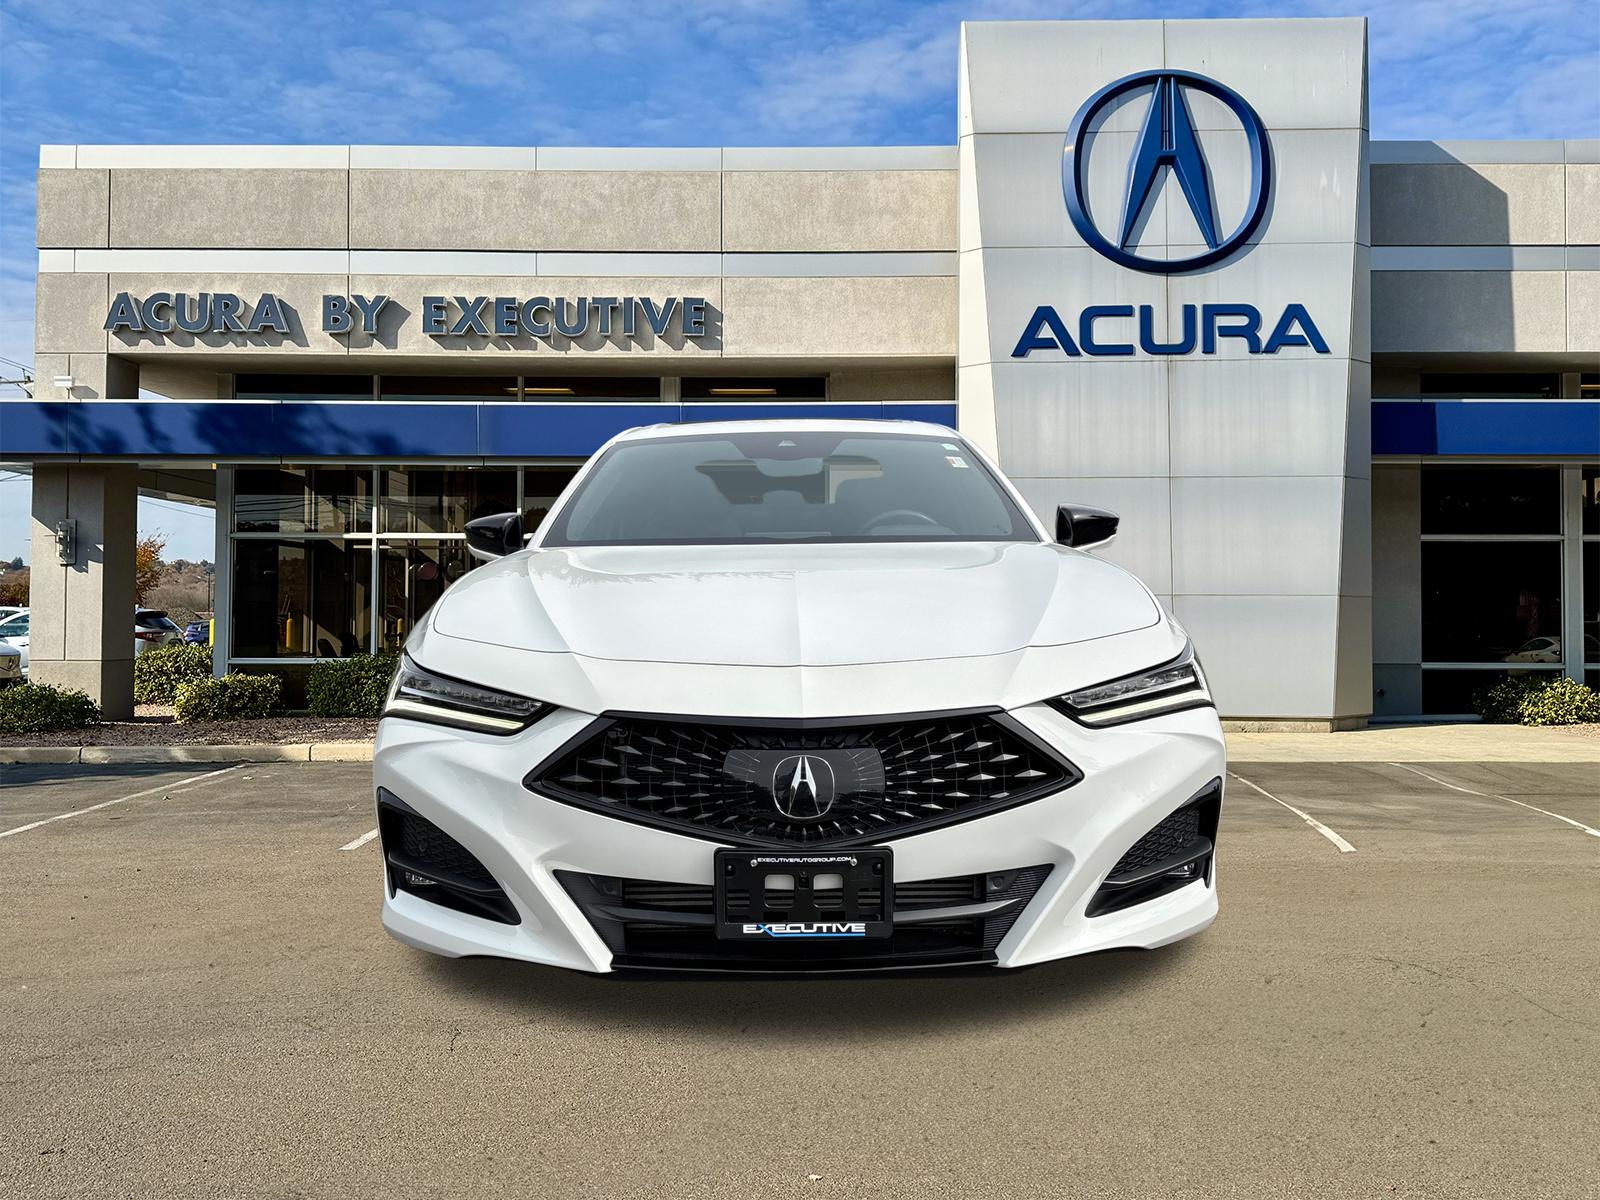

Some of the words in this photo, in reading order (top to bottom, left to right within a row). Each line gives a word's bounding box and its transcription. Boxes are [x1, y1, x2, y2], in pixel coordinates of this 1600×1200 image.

[103, 291, 290, 334] ACURA
[322, 294, 390, 334] BY
[422, 296, 705, 336] EXECUTIVE
[1011, 303, 1332, 357] ACURA
[743, 923, 866, 935] EXECUTIVE
